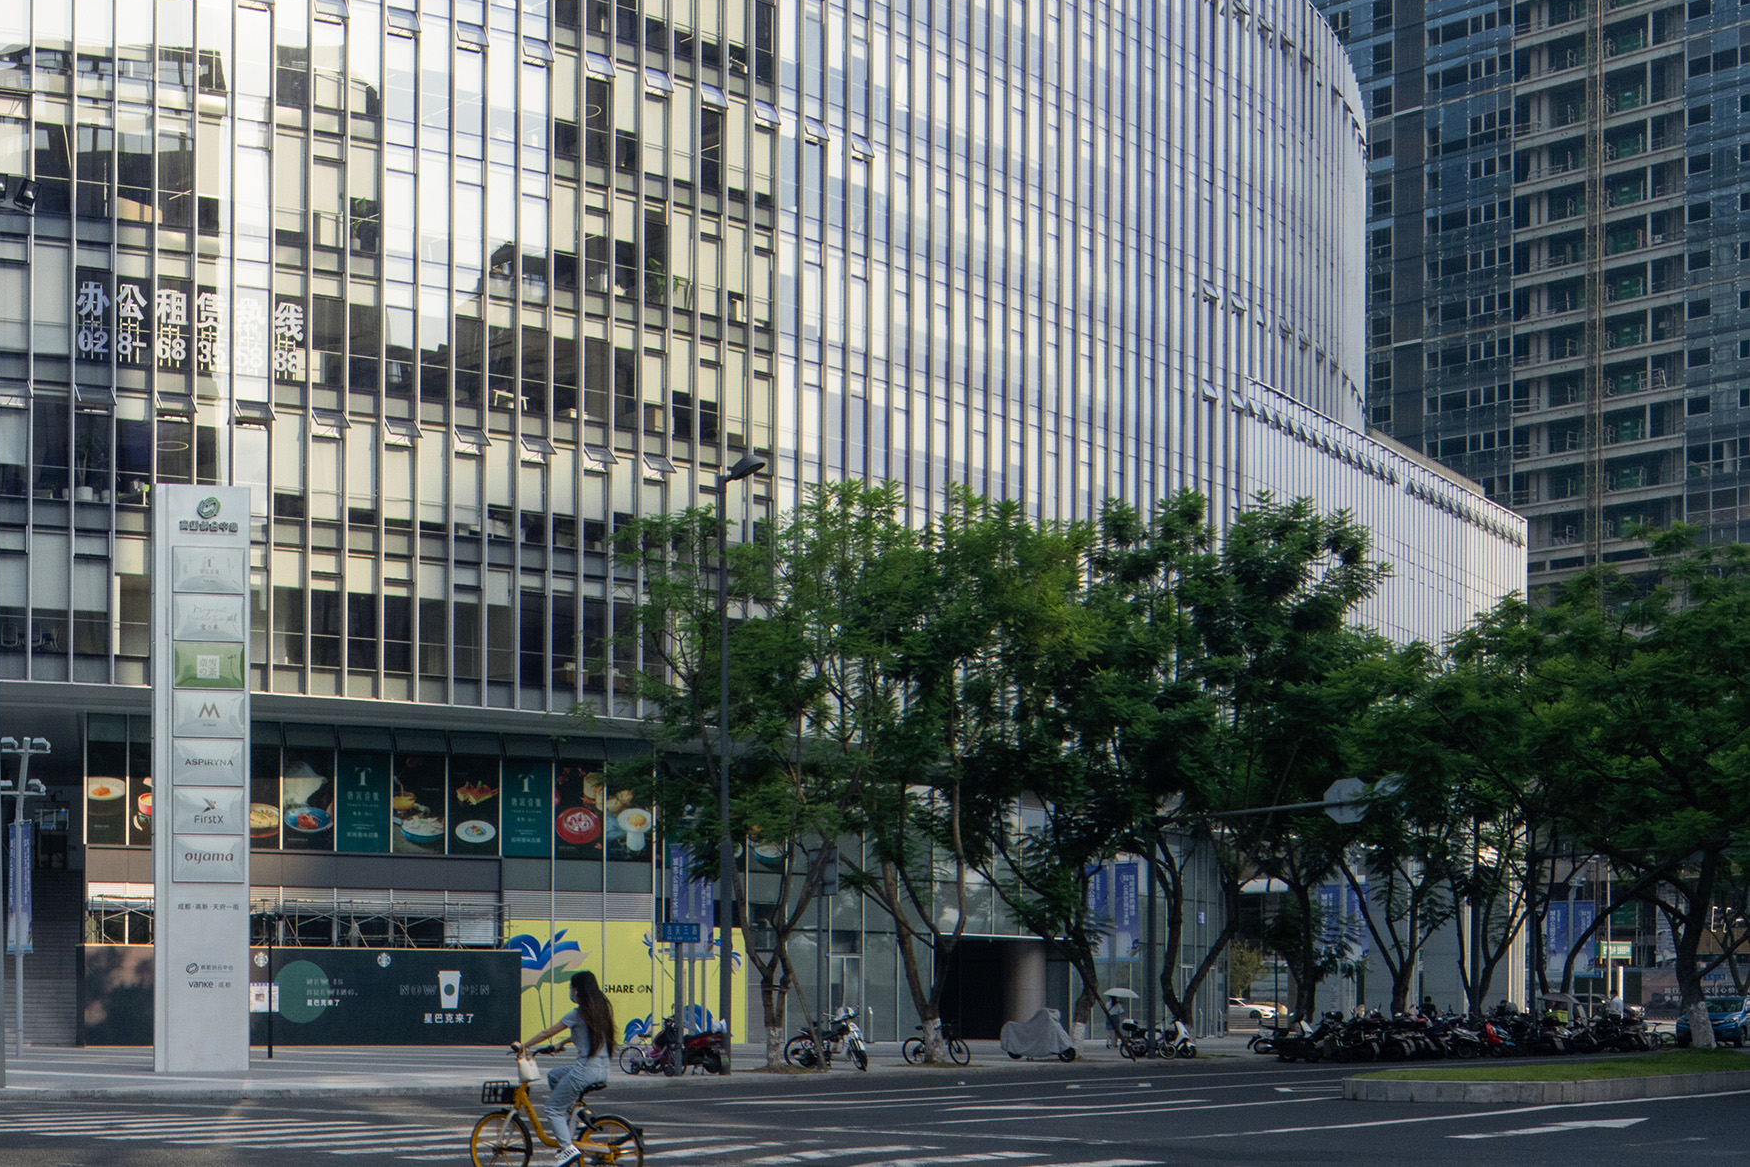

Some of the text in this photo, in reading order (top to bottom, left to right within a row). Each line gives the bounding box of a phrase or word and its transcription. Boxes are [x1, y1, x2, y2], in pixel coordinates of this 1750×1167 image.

[76, 281, 305, 341] 办公租赁热线
[78, 329, 302, 373] 028-68355888
[185, 758, 234, 766] ASPIRYNA
[194, 815, 224, 824] FirstX
[185, 852, 234, 864] oyama
[188, 981, 214, 989] vanke
[604, 984, 634, 994] SHARE
[306, 999, 340, 1007] 星巴克来了
[424, 1013, 475, 1024] 星巴克来了
